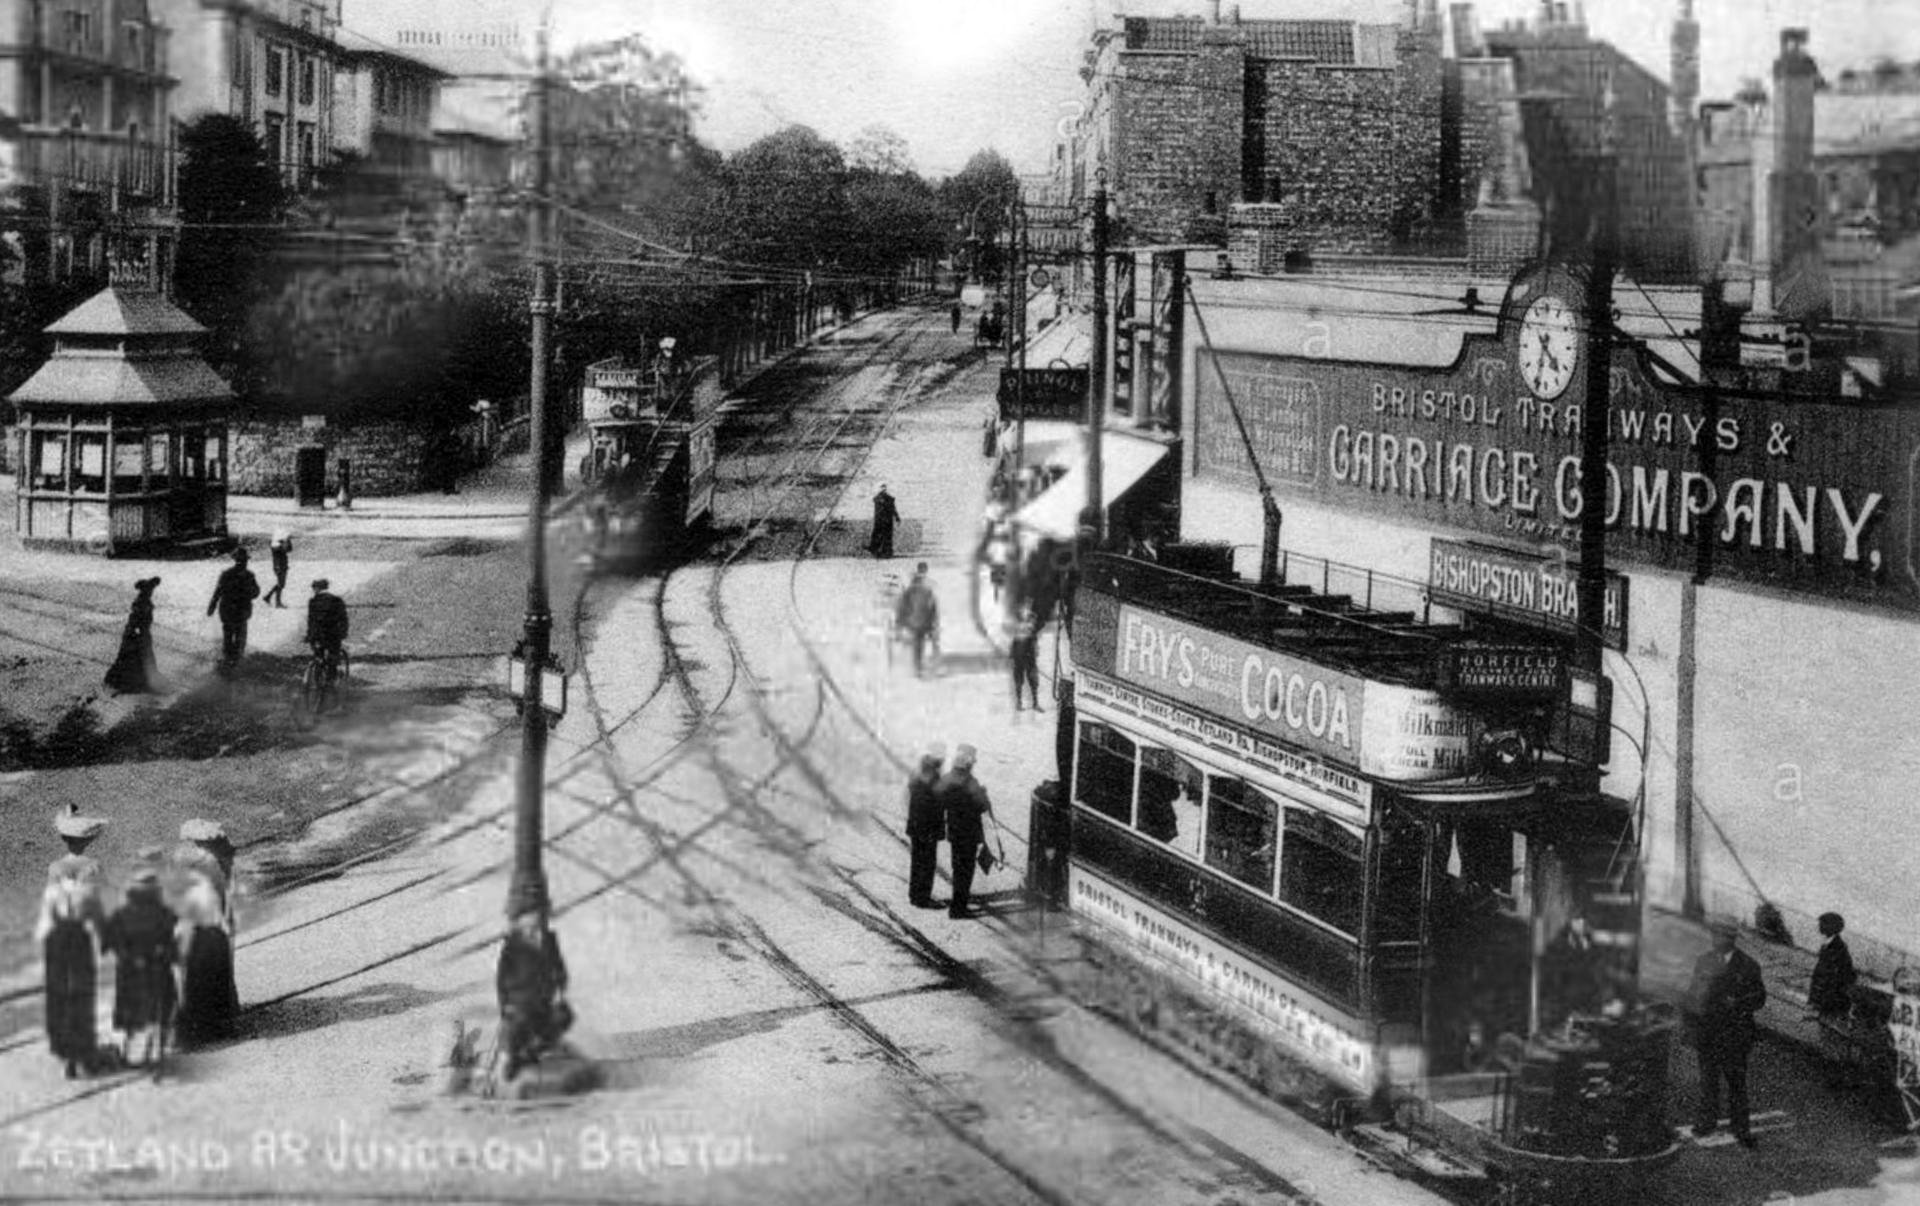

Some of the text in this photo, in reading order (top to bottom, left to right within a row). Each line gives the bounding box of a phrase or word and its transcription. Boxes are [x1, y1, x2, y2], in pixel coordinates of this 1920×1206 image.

[1372, 383, 1792, 456] BRISTOL TRAWAYS &
[1330, 424, 1539, 513] CARRIAGE
[1432, 549, 1621, 628] BISHOPSTON BRAH.
[1458, 674, 1515, 687] TRAMWAYS
[1460, 655, 1557, 668] HORFIELD
[1241, 654, 1351, 748] COCOA
[1078, 880, 1127, 919] BRISTOL
